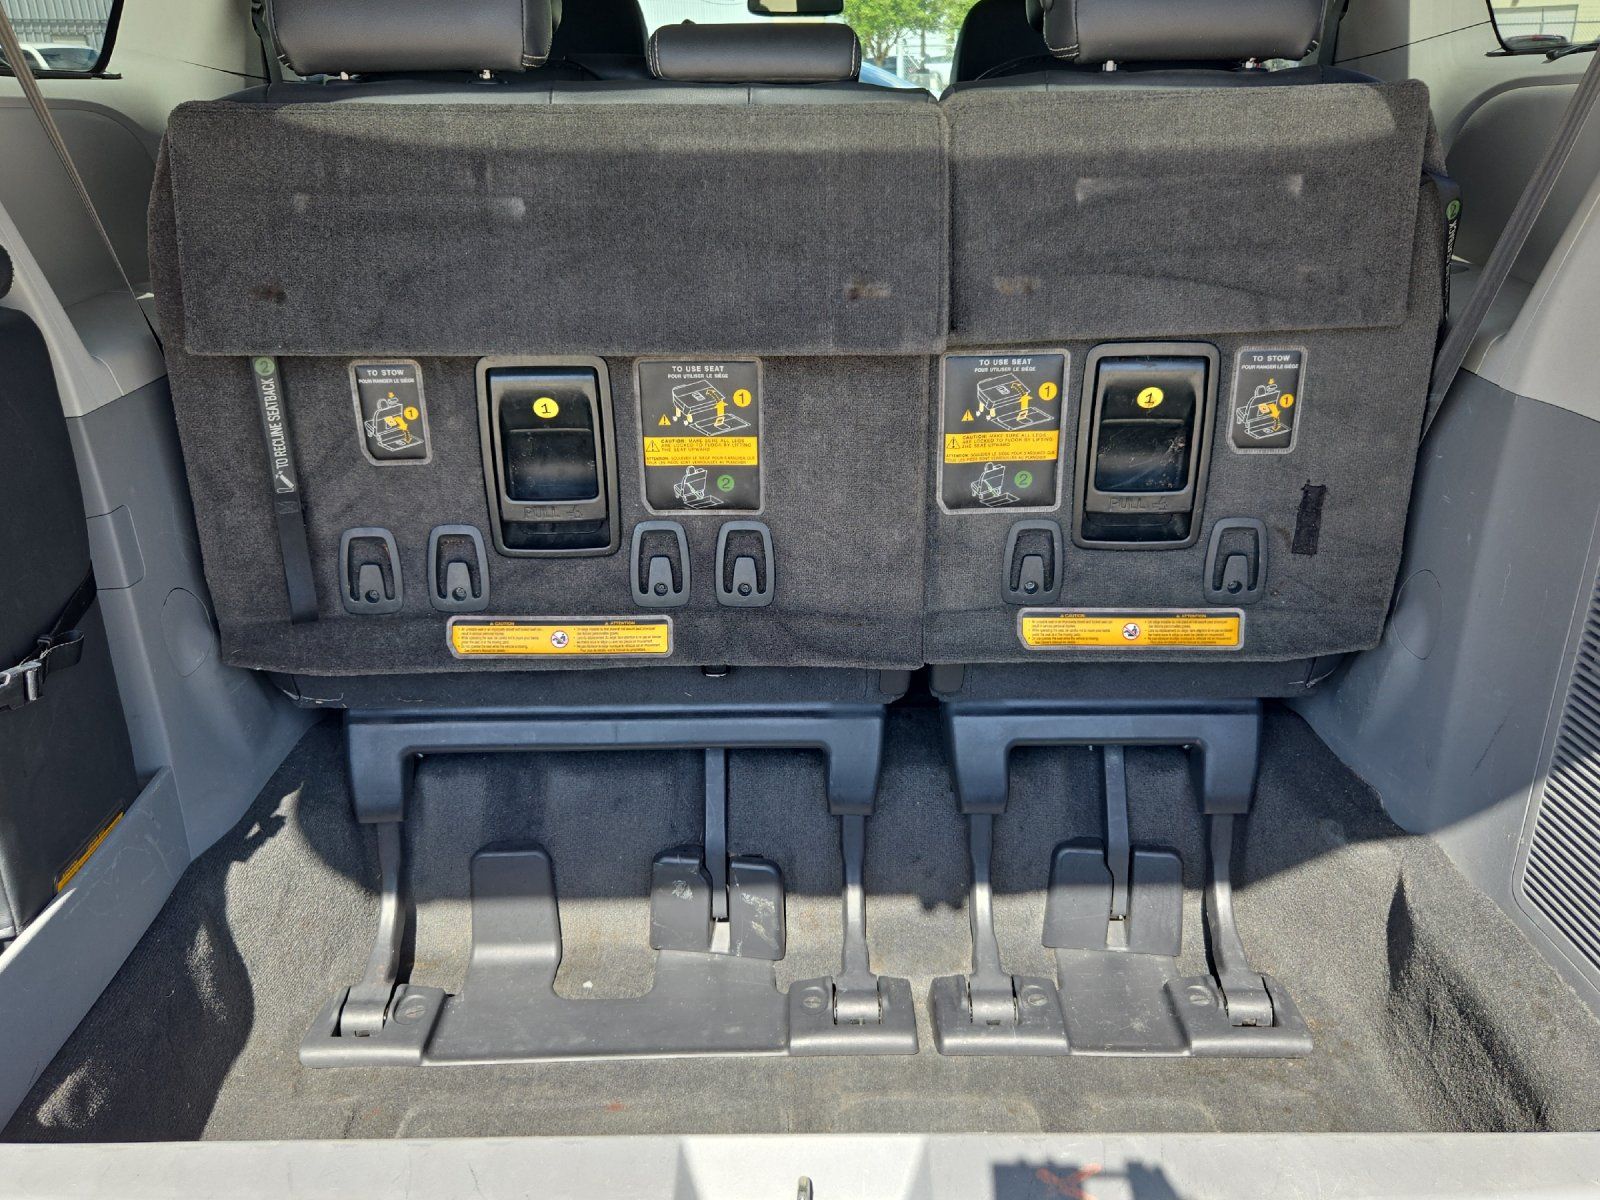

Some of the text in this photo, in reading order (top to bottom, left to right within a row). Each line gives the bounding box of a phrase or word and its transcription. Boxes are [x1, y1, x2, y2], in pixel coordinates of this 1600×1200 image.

[260, 360, 269, 373] 2
[1044, 386, 1051, 397] 1
[739, 393, 745, 404] 1
[1145, 392, 1155, 406] 1
[540, 404, 552, 414] 1
[260, 377, 289, 469] TO RECLINE SEATBACK
[722, 478, 730, 488] 2
[1019, 474, 1028, 486] 2
[1109, 497, 1146, 509] PULL
[524, 507, 560, 519] PULL
